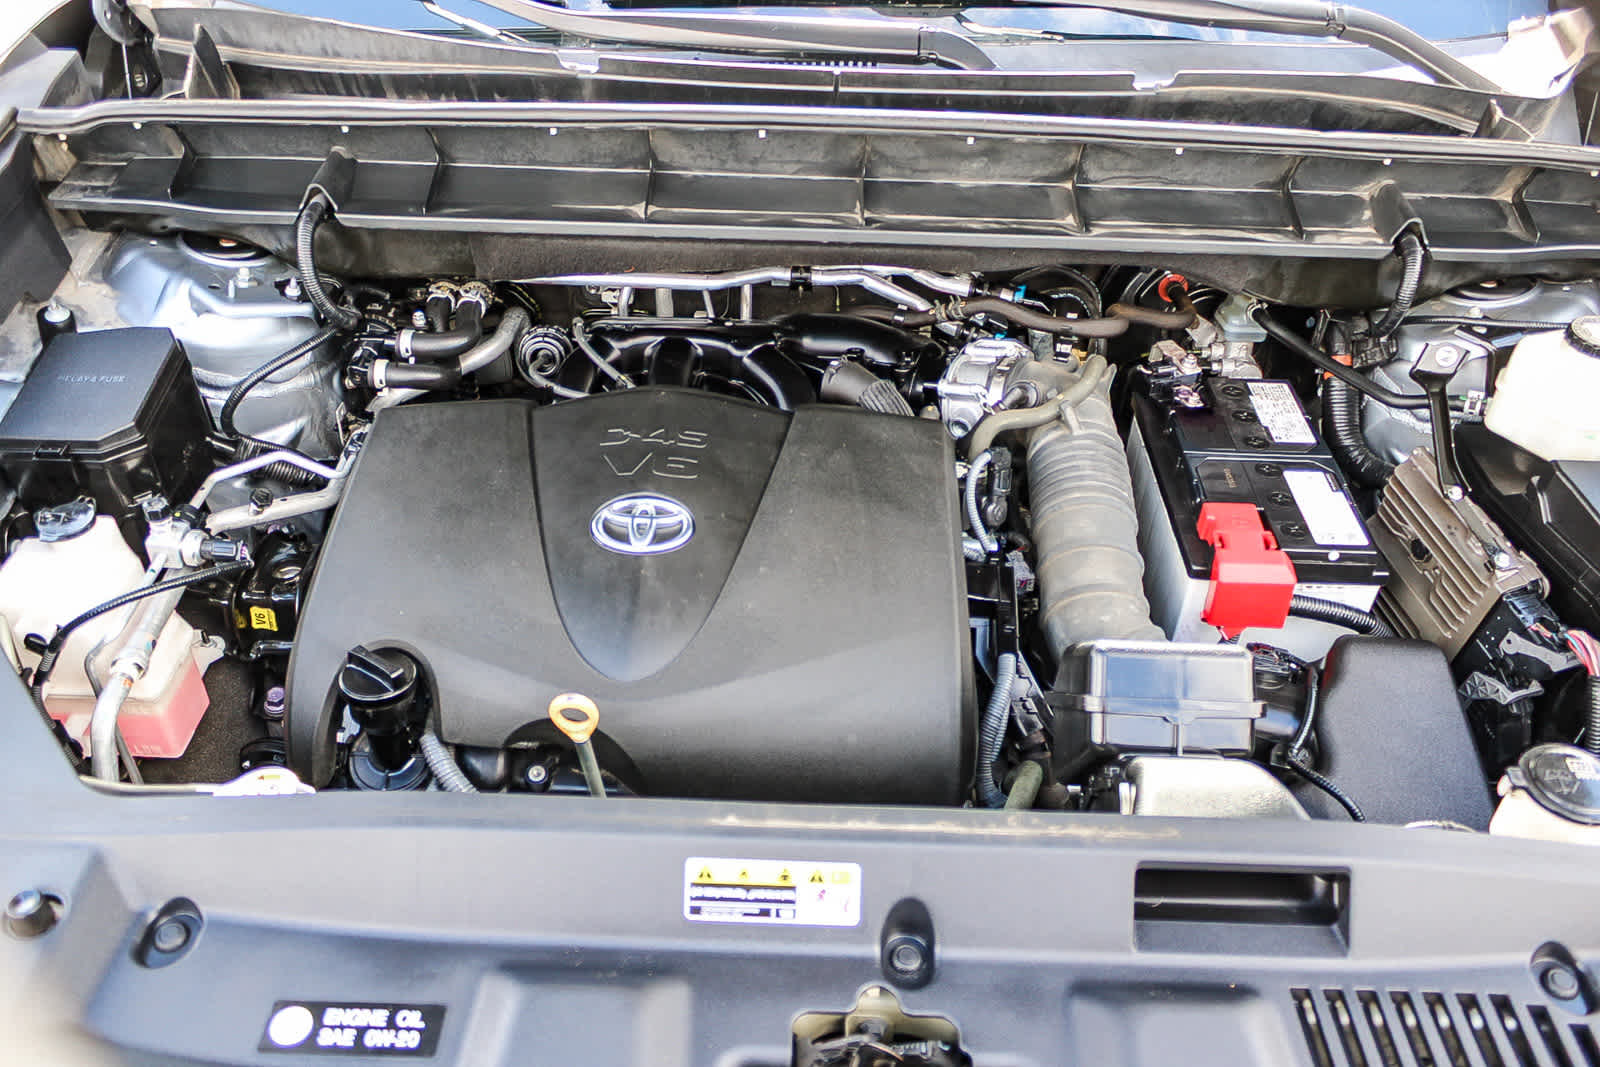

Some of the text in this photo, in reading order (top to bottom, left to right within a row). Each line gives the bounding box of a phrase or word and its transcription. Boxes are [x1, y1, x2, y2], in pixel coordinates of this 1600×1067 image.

[602, 452, 699, 479] V6
[255, 612, 266, 625] V6
[322, 1007, 426, 1029] ENGINE OIL
[316, 1027, 357, 1047] SAE
